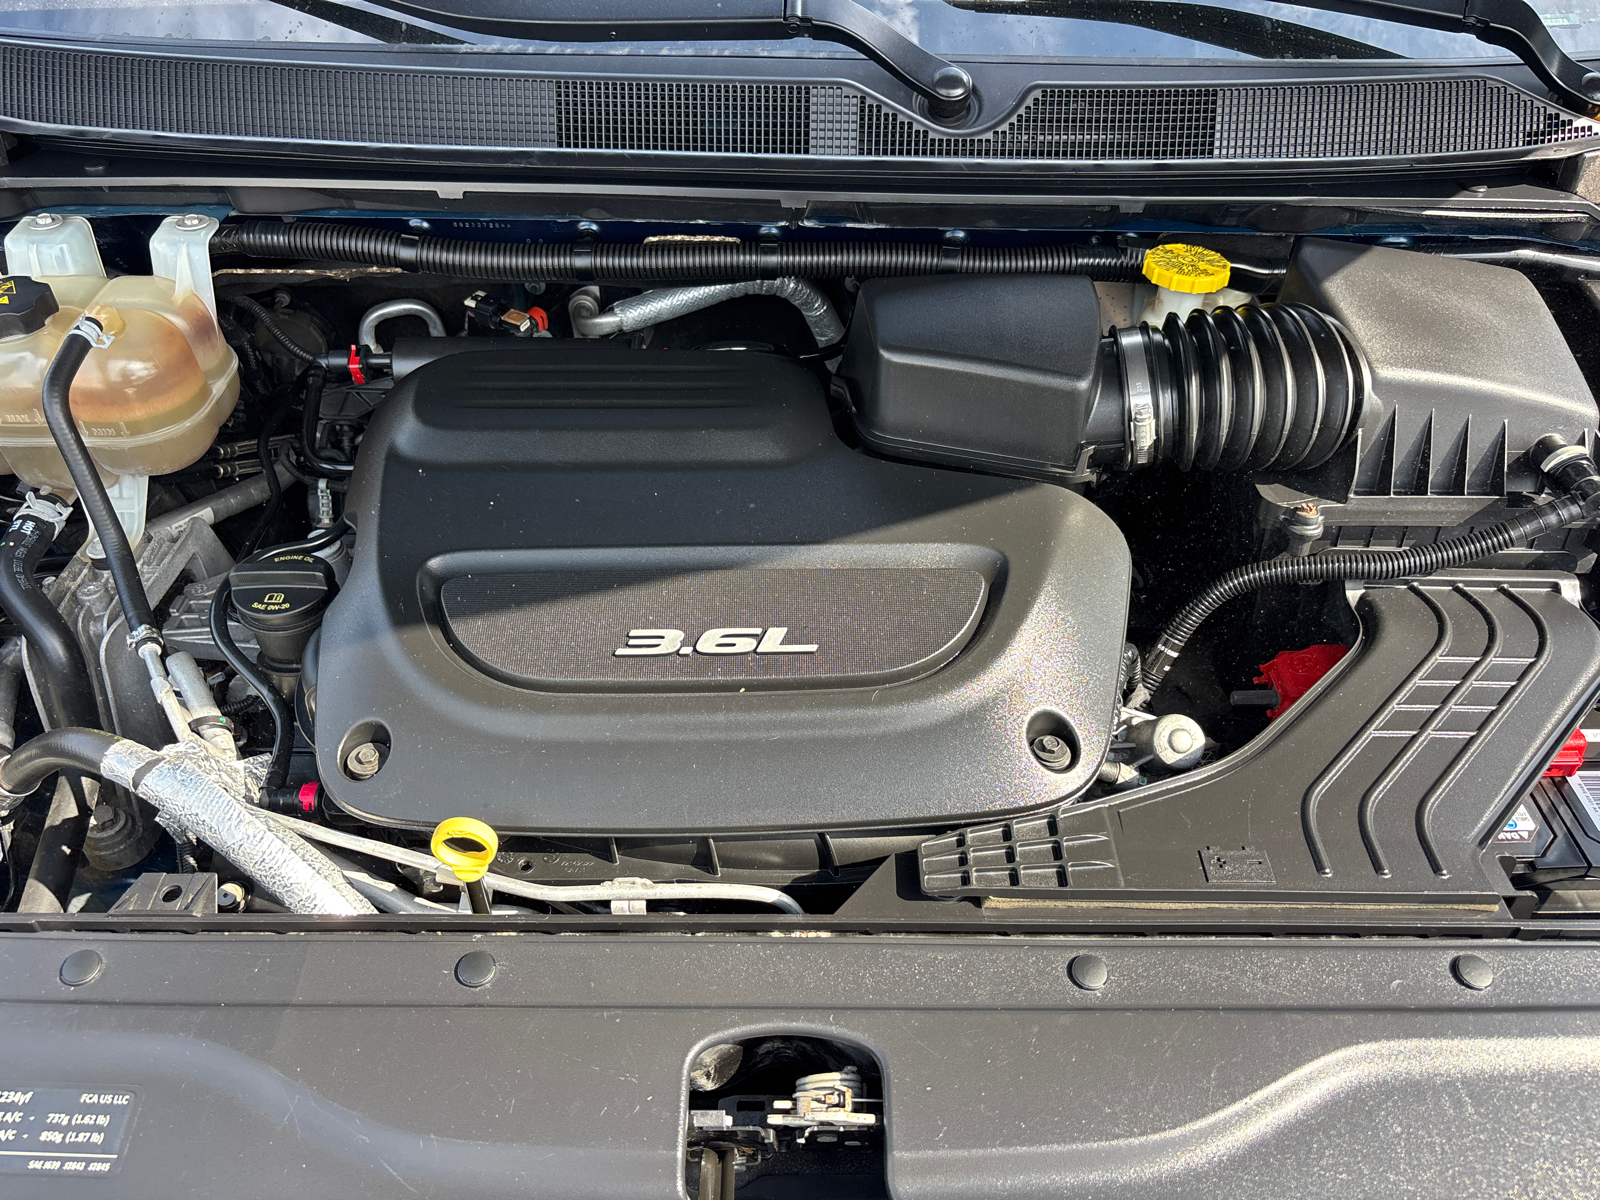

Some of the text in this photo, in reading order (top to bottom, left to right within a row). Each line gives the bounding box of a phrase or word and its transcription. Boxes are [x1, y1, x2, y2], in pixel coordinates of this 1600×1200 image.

[20, 520, 36, 535] HOT
[274, 555, 316, 564] ENGINE OIL
[251, 602, 291, 611] SAE 0W-20
[612, 627, 819, 657] 3.6L
[80, 1093, 131, 1105] FCA US LLC
[3, 1111, 24, 1124] A/C
[46, 1113, 71, 1126] 737g
[71, 1113, 97, 1126] (1.62
[96, 1114, 111, 1127] lb)
[39, 1130, 65, 1144] 850g
[65, 1131, 91, 1145] (1.87
[89, 1132, 105, 1145] lb)
